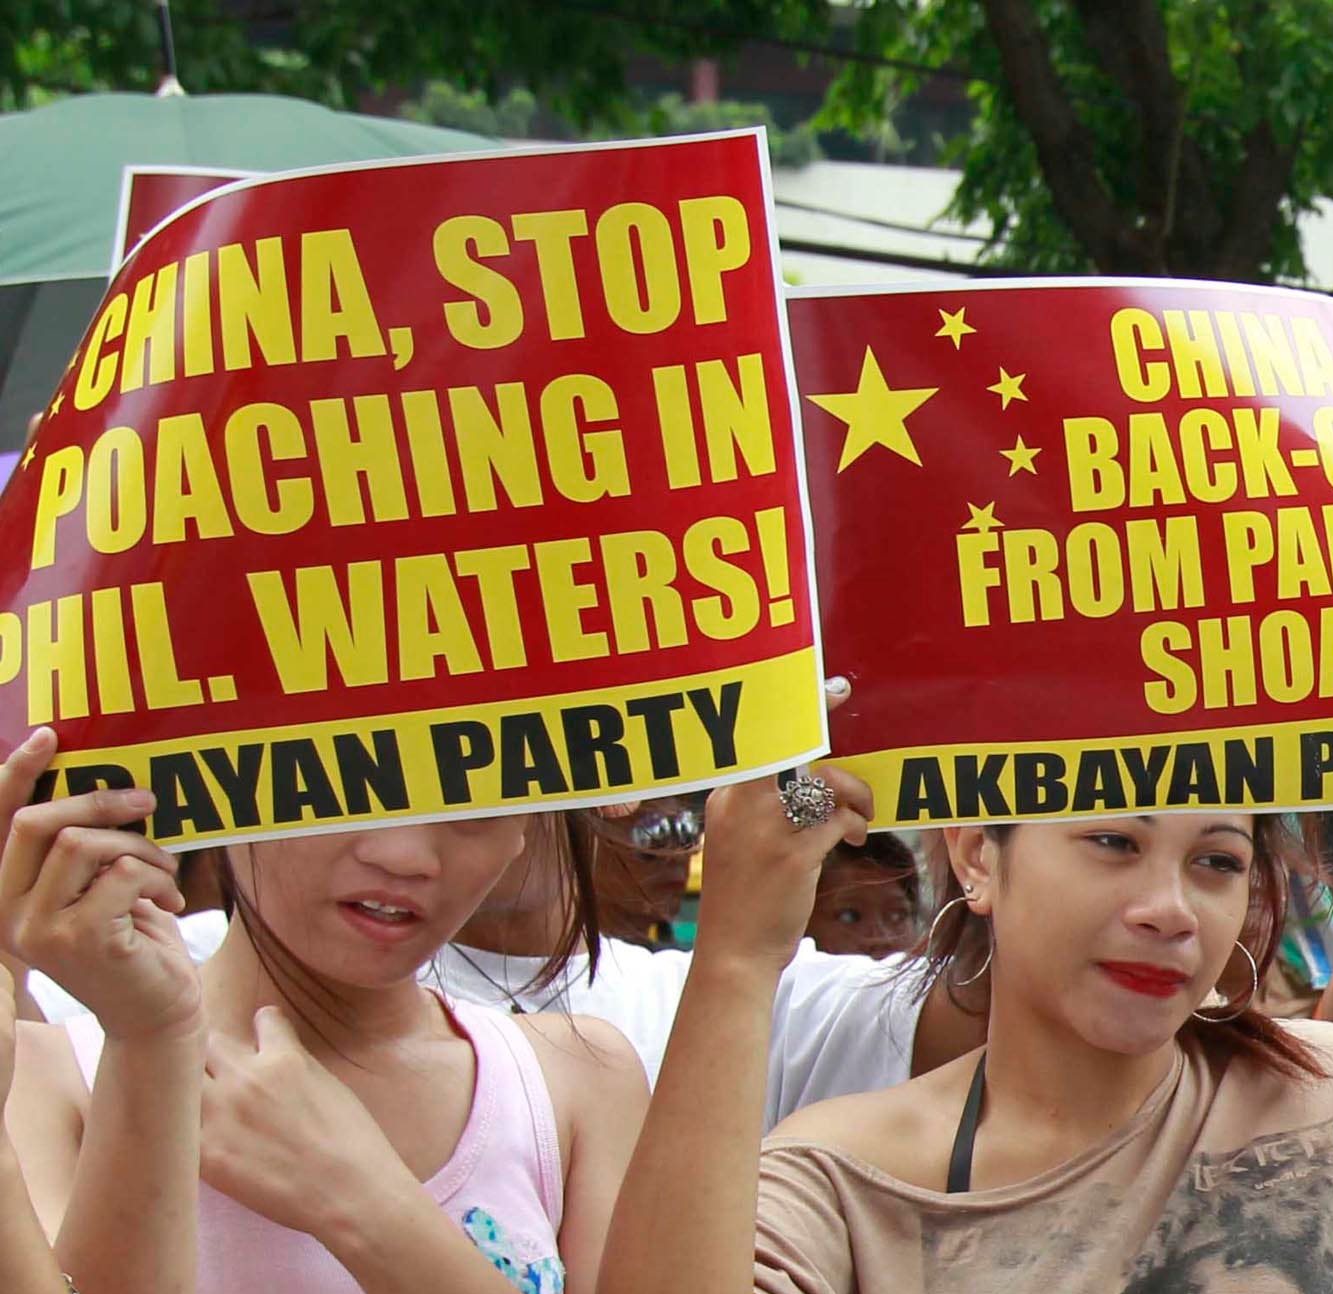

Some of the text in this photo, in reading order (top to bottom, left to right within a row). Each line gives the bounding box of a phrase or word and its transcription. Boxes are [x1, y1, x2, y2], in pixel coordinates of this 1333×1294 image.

[73, 195, 751, 411] CHINA, STOP
[31, 353, 777, 570] POACHING IN
[246, 507, 796, 695] WATERS!
[954, 513, 1206, 628] FROM
[428, 681, 743, 806] PARTY
[895, 735, 1276, 822] AKBAYAN
